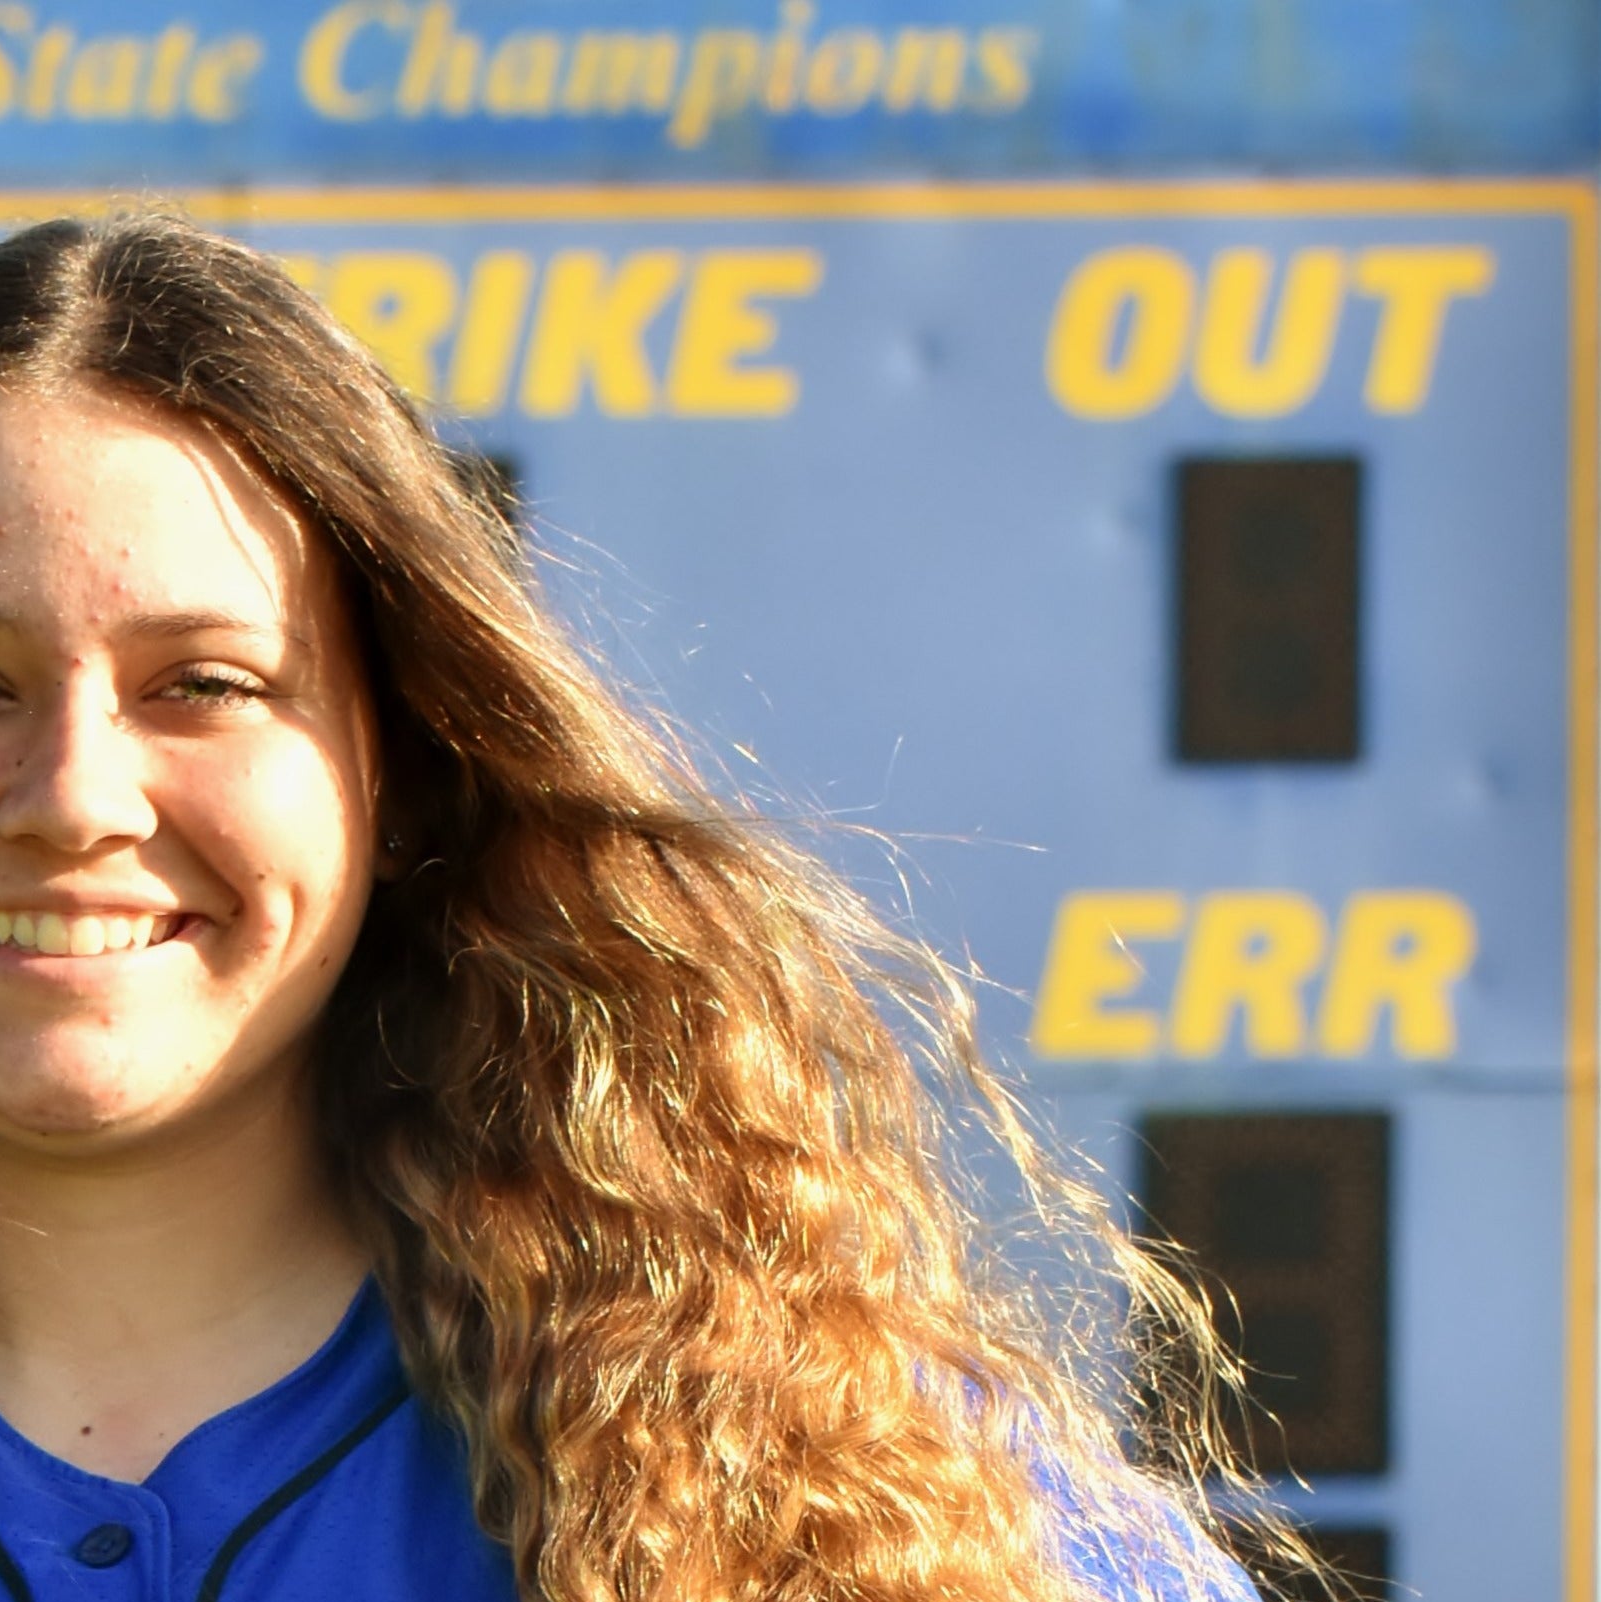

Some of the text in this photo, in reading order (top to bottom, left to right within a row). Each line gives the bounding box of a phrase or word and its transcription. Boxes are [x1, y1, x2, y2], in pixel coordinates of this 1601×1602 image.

[299, 2, 1040, 150] Champions
[266, 247, 823, 418] RIKE
[1043, 244, 1498, 421] OUT
[1027, 889, 1478, 1062] ERR
